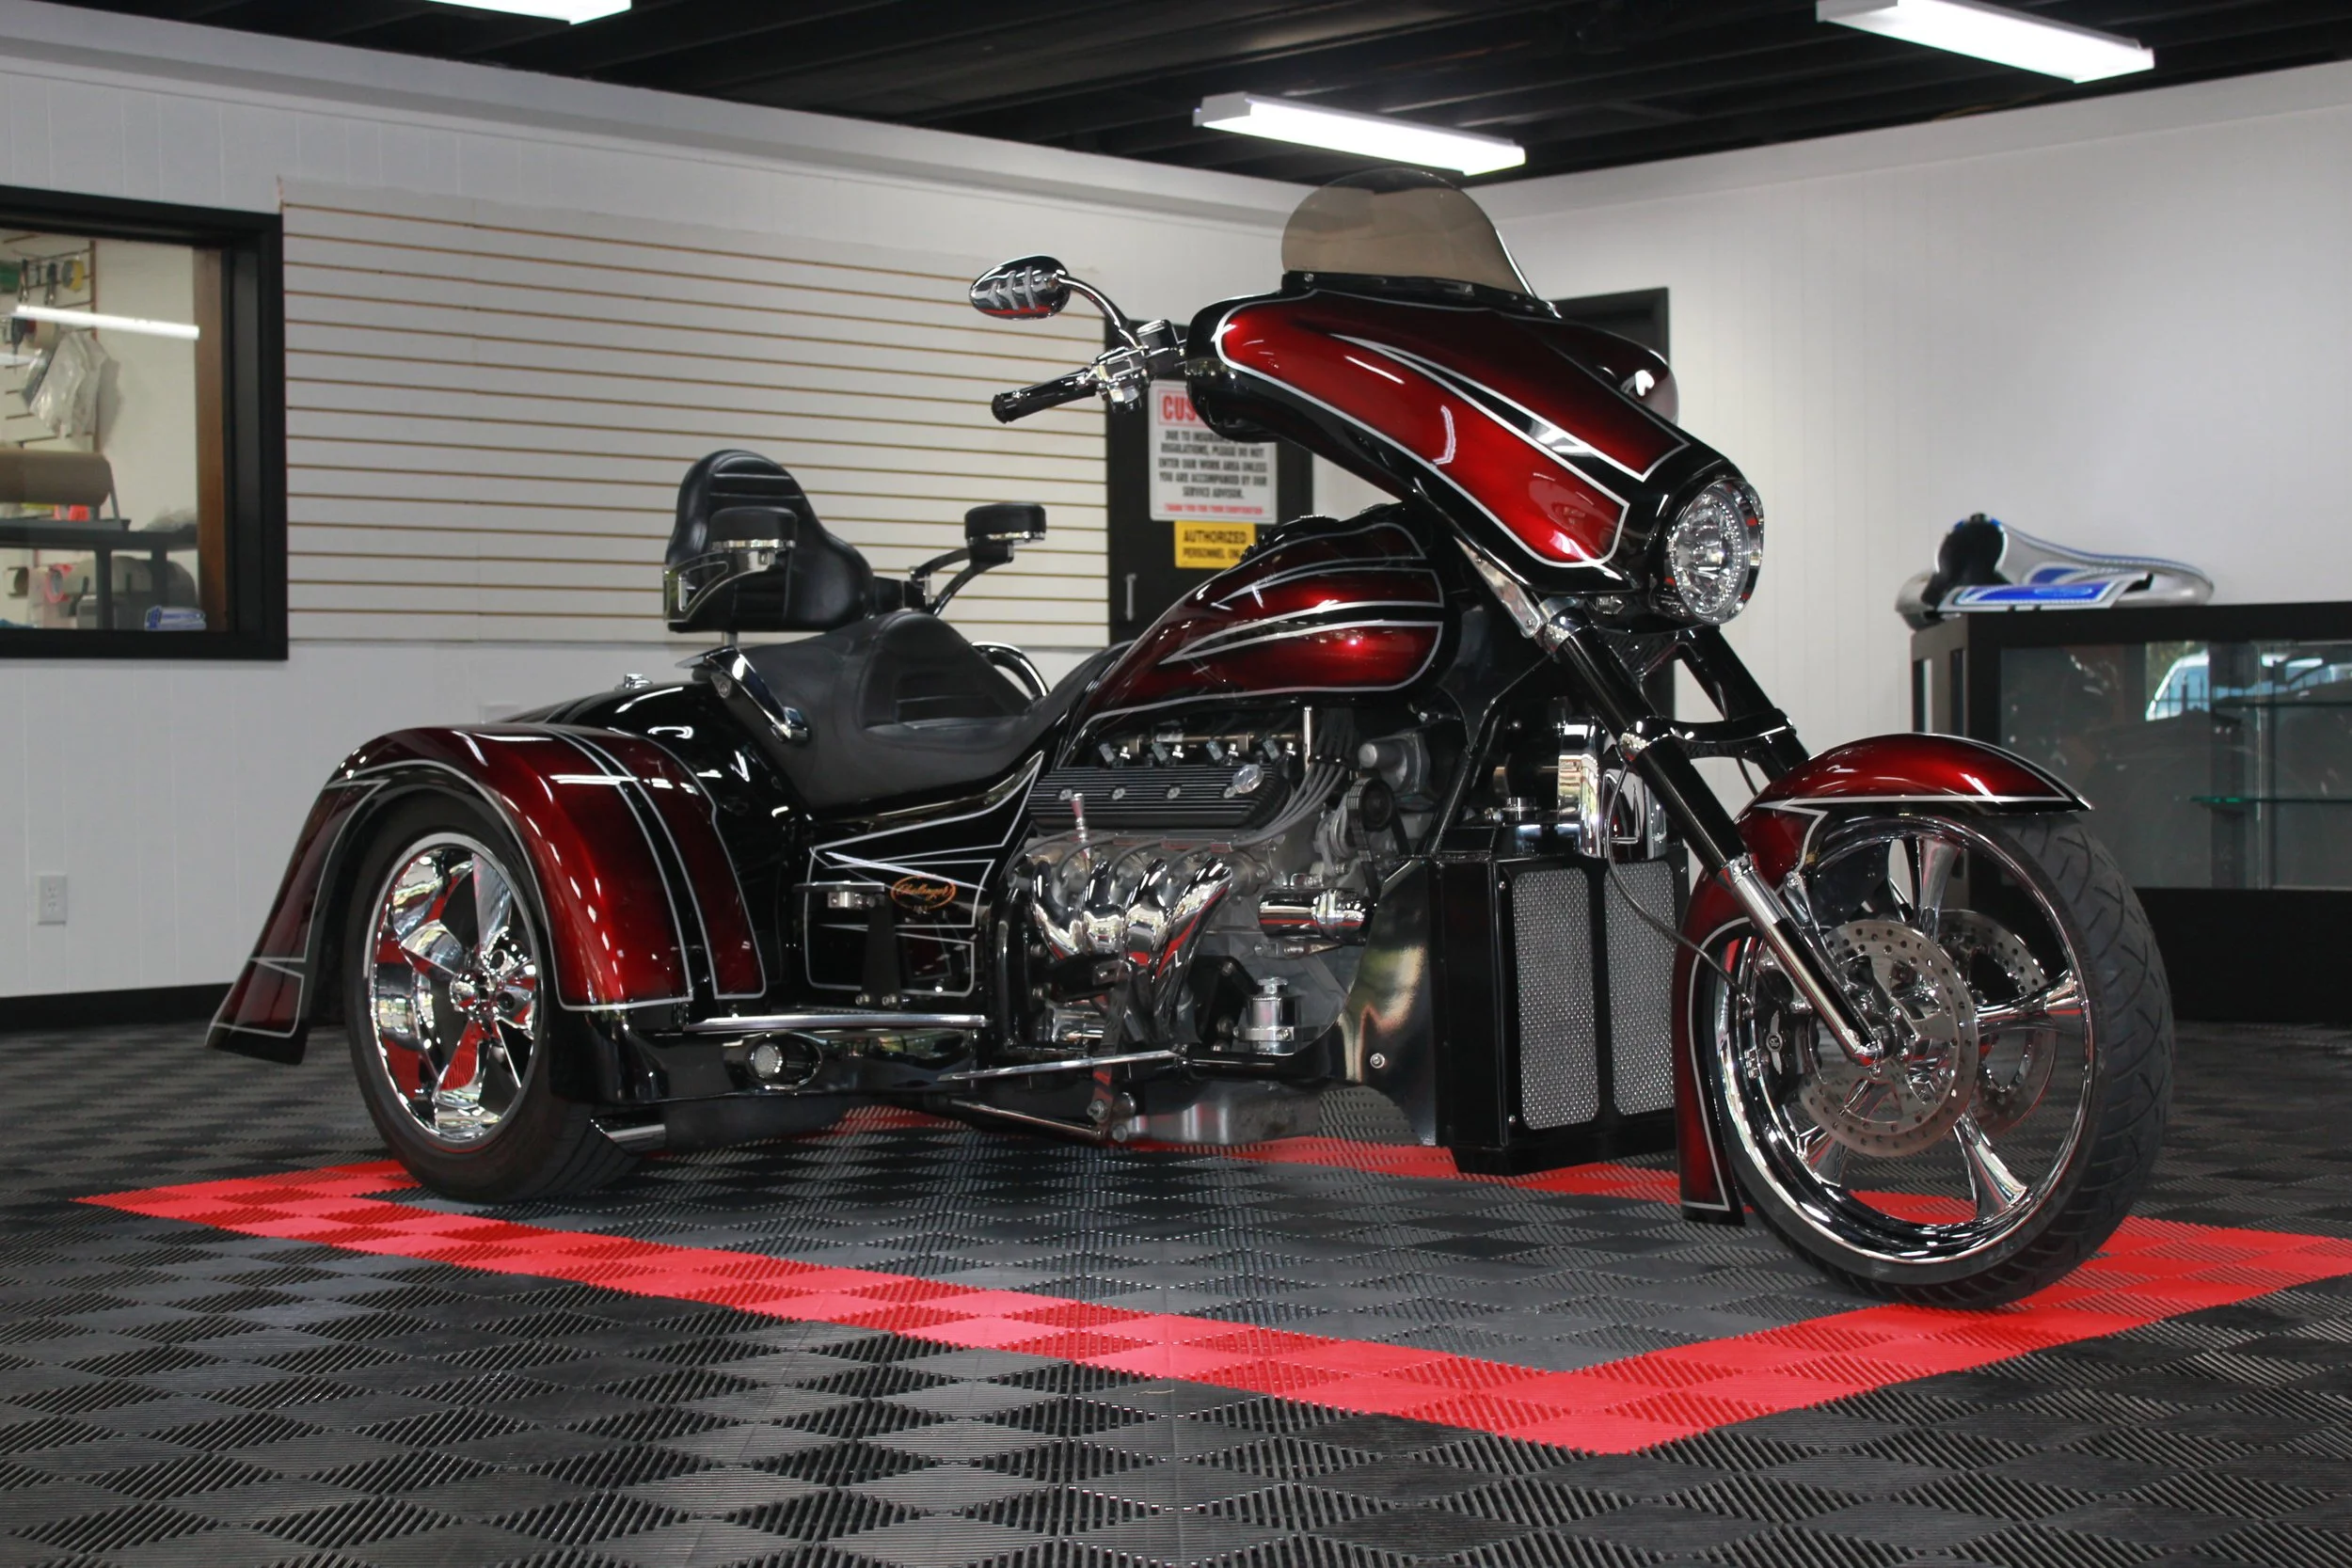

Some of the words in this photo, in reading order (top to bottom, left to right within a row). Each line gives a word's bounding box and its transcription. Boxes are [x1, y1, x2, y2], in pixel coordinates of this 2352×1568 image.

[1181, 430, 1190, 441] TO
[1212, 445, 1236, 456] PLEASE
[1238, 447, 1248, 457] DO
[1249, 448, 1264, 457] NOT
[1158, 457, 1180, 467] ENTER
[1182, 458, 1197, 469] OUR
[1200, 459, 1220, 470] WORK
[1223, 461, 1240, 471] AREA
[1243, 462, 1267, 473] UNLESS
[1159, 471, 1173, 482] YOU
[1175, 472, 1188, 483] ARE
[1190, 473, 1239, 485] ACCOMPANIED
[1241, 474, 1250, 486] BY
[1252, 475, 1267, 486] OUR
[1183, 486, 1210, 498] SERVICE
[1184, 530, 1248, 545] AUTHORIZED
[1183, 547, 1226, 559] PERSONNEL
